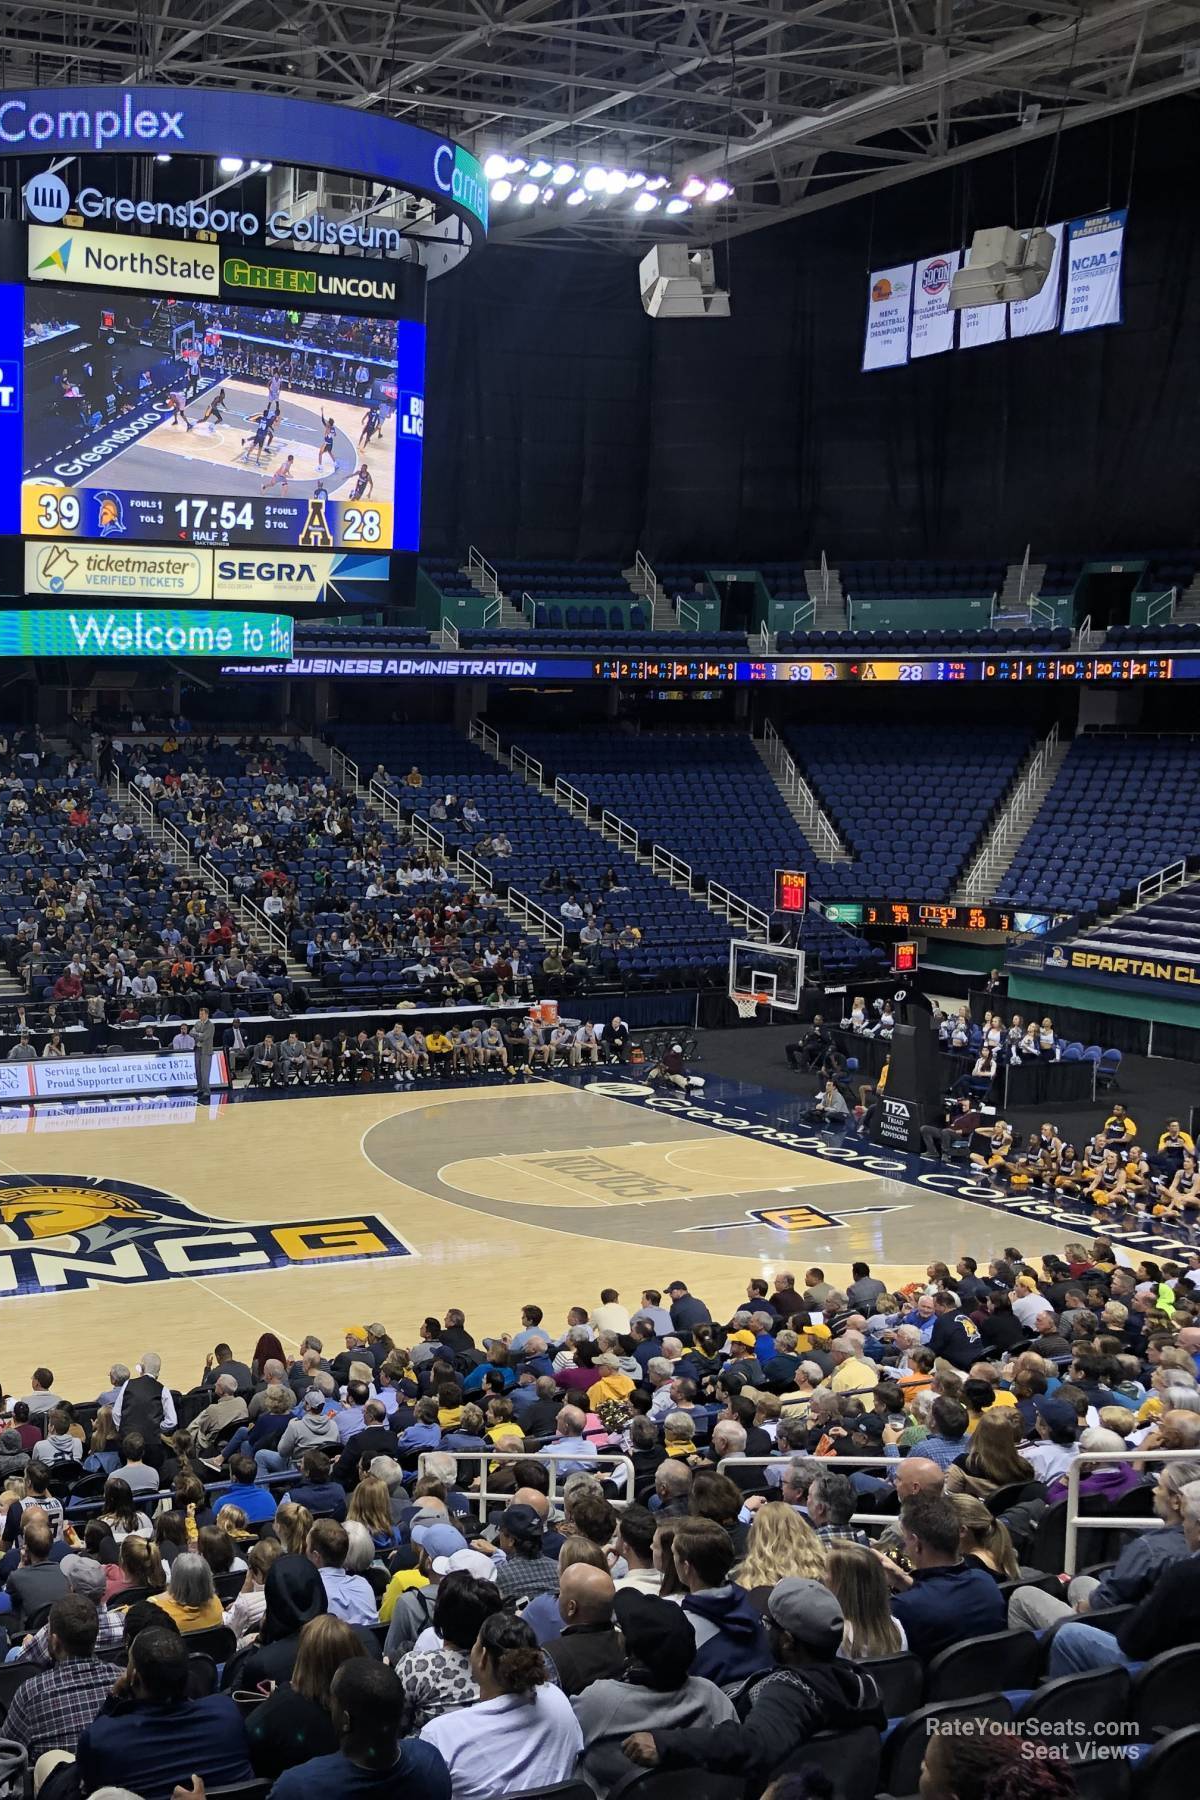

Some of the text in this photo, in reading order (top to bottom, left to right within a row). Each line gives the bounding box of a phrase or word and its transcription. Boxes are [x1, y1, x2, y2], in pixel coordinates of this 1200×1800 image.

[77, 187, 401, 250] Greensboro Coliseum
[1085, 216, 1110, 227] MEN'S
[1072, 220, 1121, 239] BASKETBALL
[85, 246, 216, 280] NorthState
[1071, 253, 1107, 271] NCAA
[224, 259, 395, 300] GREEN LINCOLN
[879, 308, 899, 317] MEN'S
[1070, 305, 1089, 315] 2018
[870, 318, 906, 329] BASKETBALL
[870, 326, 905, 338] CHAMPIONS
[54, 411, 162, 477] Greensboro
[130, 500, 162, 510] FOULS 1
[37, 494, 80, 530] 39
[175, 500, 254, 530] 17:54
[265, 506, 298, 516] 2 FOULS
[139, 515, 164, 524] TOL 3
[265, 520, 288, 529] 3 TOL
[299, 499, 334, 547] A
[343, 509, 381, 542] 28
[193, 531, 228, 541] HALF 2
[86, 554, 190, 575] ticketmaster
[218, 561, 316, 582] SEGRA
[85, 574, 185, 588] VERIFIED TICKETS
[69, 612, 233, 651] Welcome
[243, 620, 264, 652] to
[285, 659, 384, 674] BUSINESS
[384, 660, 537, 675] ADMINISTRATION
[595, 664, 600, 674] 1
[621, 665, 627, 674] 2
[647, 665, 658, 675] 14
[676, 665, 687, 675] 21
[707, 665, 719, 676] 44
[750, 663, 766, 671] TOL
[789, 665, 812, 680] 39
[863, 664, 877, 679] A
[898, 665, 923, 680] 28
[986, 666, 995, 676] 0
[1025, 665, 1032, 675] 1
[1060, 664, 1075, 675] 10
[1097, 663, 1111, 674] 20
[1133, 664, 1147, 674] 21
[771, 672, 776, 680] 1
[938, 672, 944, 680] 2
[783, 875, 804, 887] 17:54
[783, 887, 801, 908] 30
[869, 911, 876, 922] 3
[894, 913, 909, 922] 39
[923, 907, 955, 918] 17:54
[941, 919, 947, 927] 2
[969, 917, 986, 928] 28
[1002, 919, 1008, 929] 3
[1072, 952, 1200, 984] SPARTAN CL
[45, 1059, 192, 1077] Serving the local area since 1872.
[46, 1077, 76, 1089] Proud
[77, 1075, 123, 1089] Supporter
[126, 1074, 136, 1083] of
[137, 1072, 168, 1083] UNCG
[883, 1100, 911, 1118] TFA
[887, 1116, 905, 1126] TRIAD
[880, 1121, 910, 1135] FINANCIAL
[645, 1097, 907, 1171] Greensboro
[880, 1130, 908, 1142] ADVISORS
